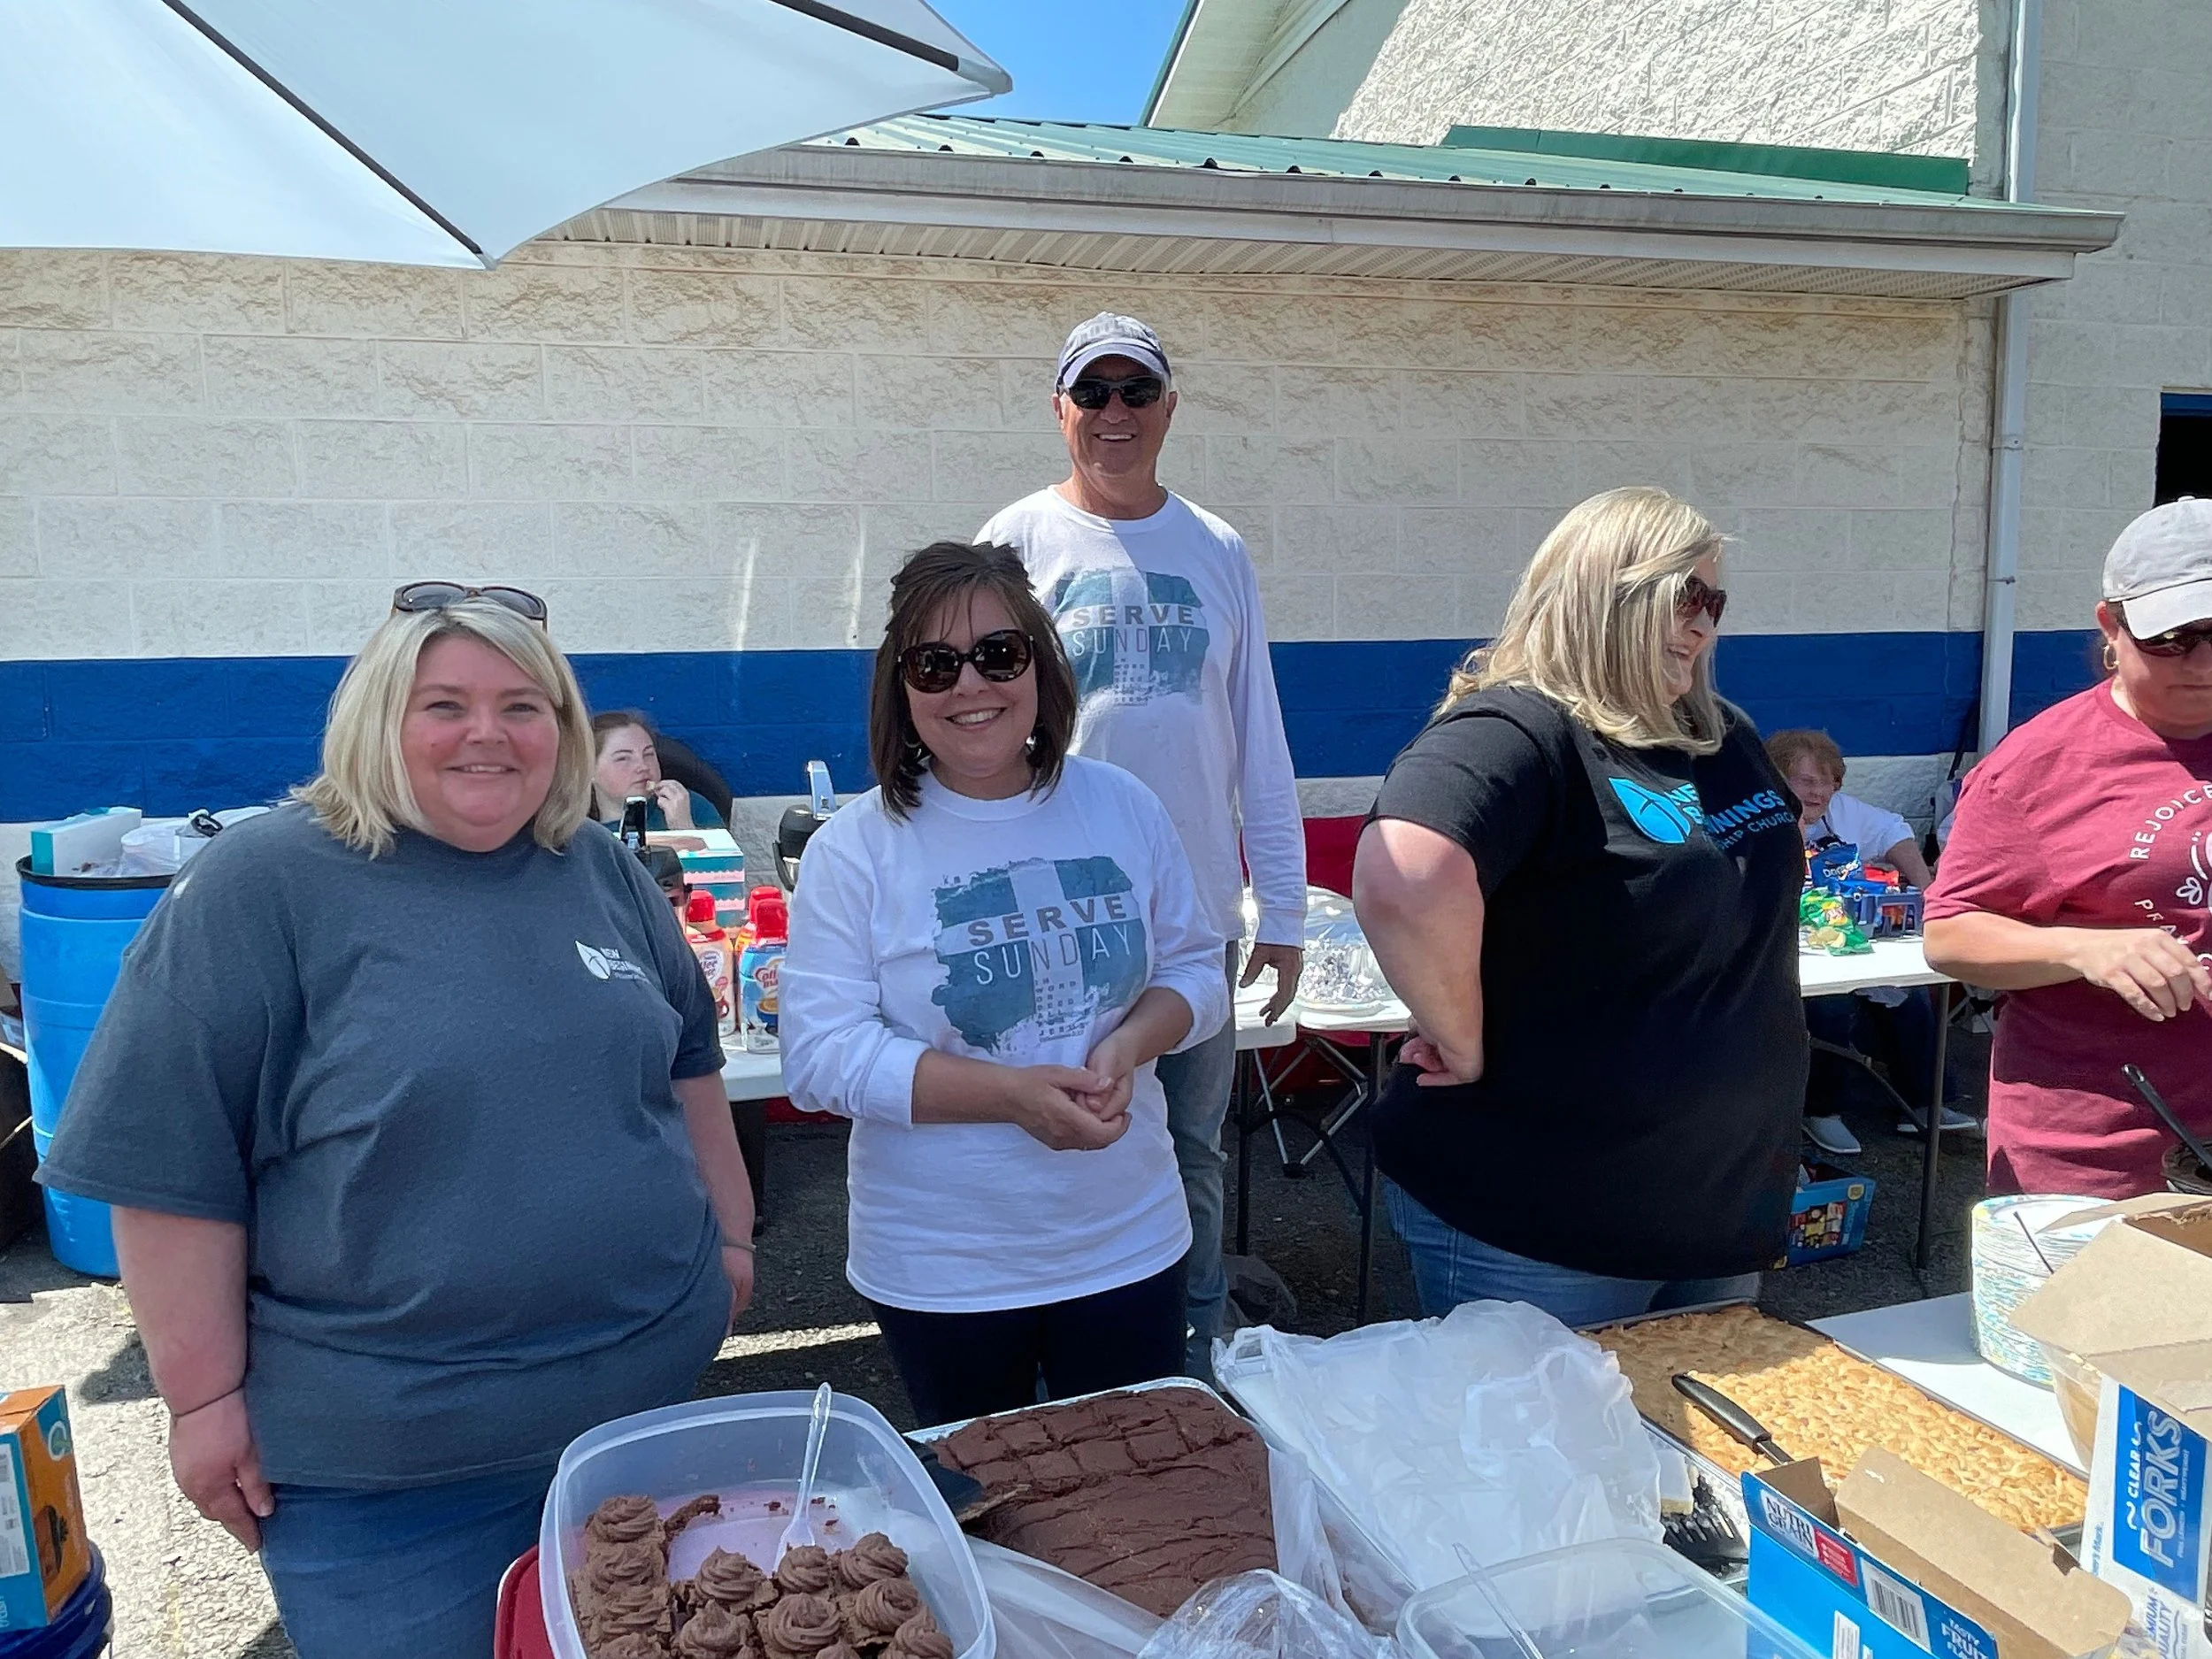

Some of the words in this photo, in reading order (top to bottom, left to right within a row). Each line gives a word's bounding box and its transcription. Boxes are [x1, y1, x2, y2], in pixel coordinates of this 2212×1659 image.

[1071, 604, 1194, 627] SERVE
[1071, 628, 1192, 657] SUNDAY
[967, 895, 1126, 947] SERVE
[974, 924, 1132, 985] SUNDAY
[1035, 980, 1076, 993] WORD
[2127, 1449, 2141, 1499] CLEAR
[2139, 1409, 2183, 1569] FORKS
[1766, 1496, 1810, 1537] NUTRI
[1769, 1512, 1814, 1550] GRAIN
